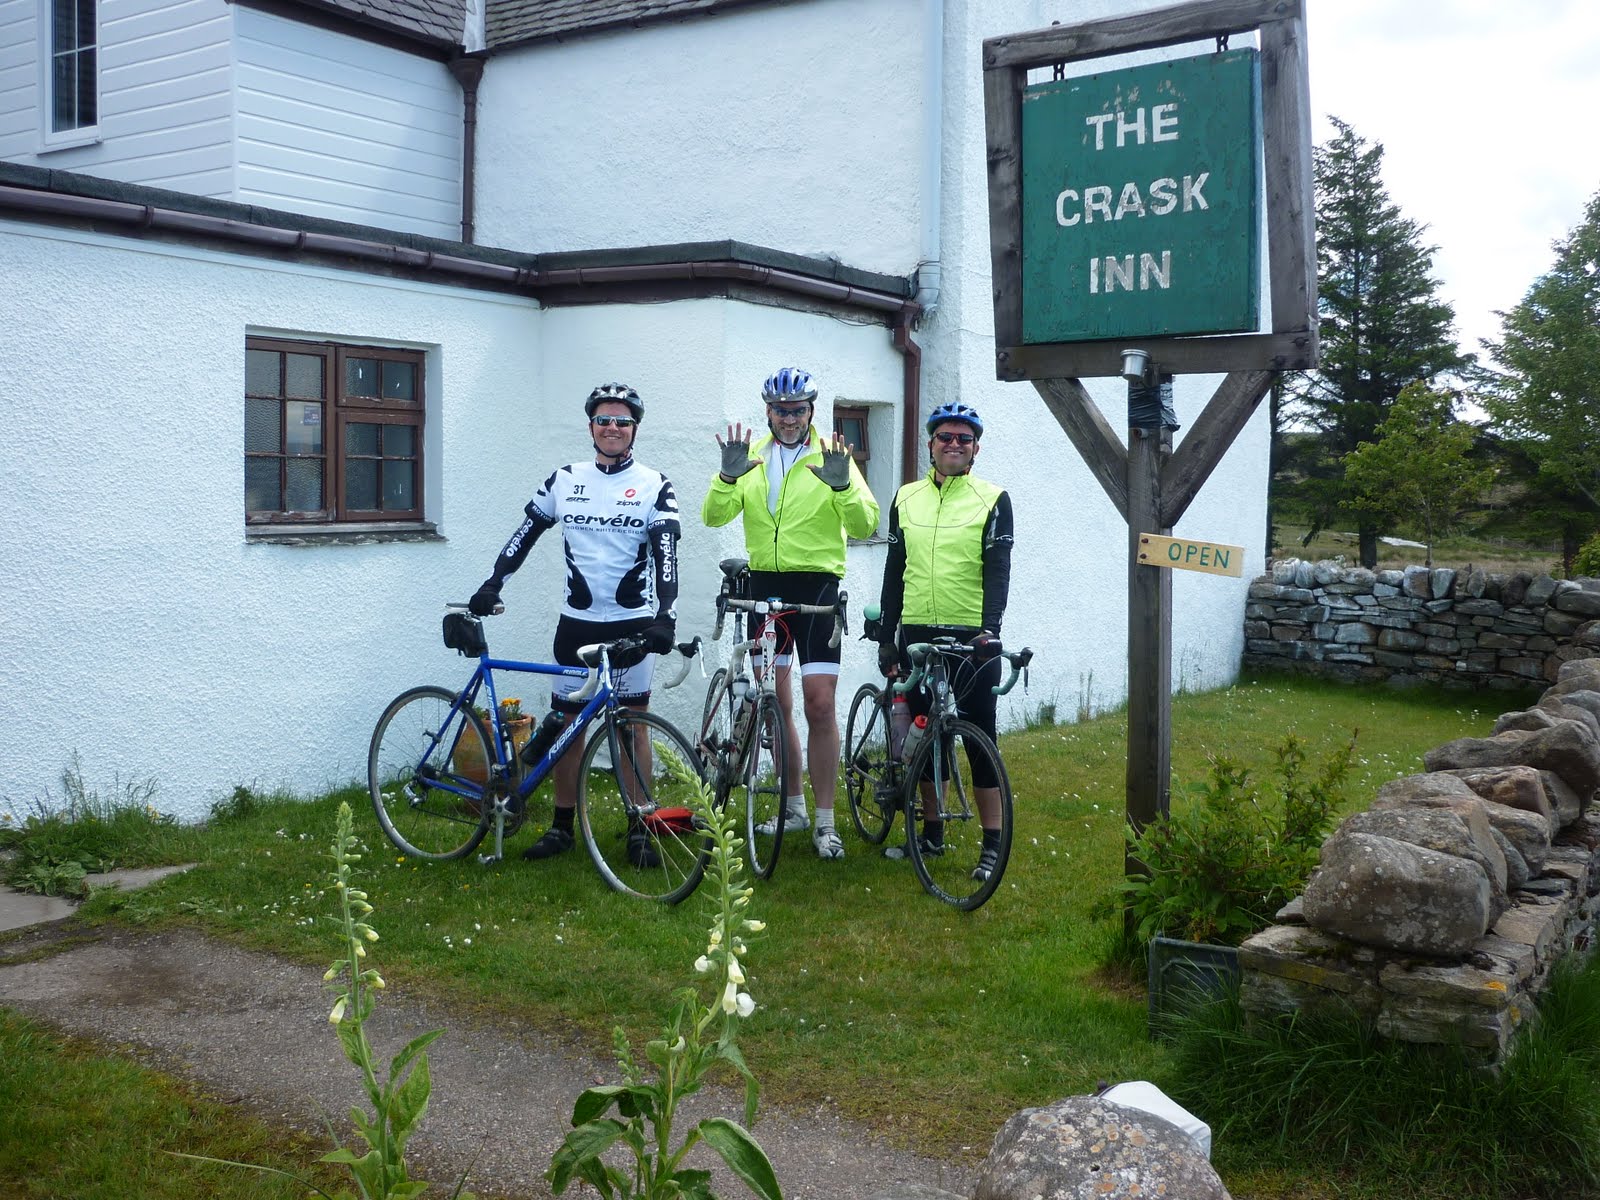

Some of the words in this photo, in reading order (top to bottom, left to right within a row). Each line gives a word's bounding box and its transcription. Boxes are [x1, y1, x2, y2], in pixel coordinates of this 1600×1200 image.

[1086, 103, 1179, 151] THE
[1056, 172, 1210, 226] CRASK
[1090, 250, 1171, 294] INN
[573, 484, 586, 495] 3T
[563, 513, 645, 528] cervélo
[1168, 543, 1230, 568] OPEN
[548, 713, 584, 760] RIBBLE
